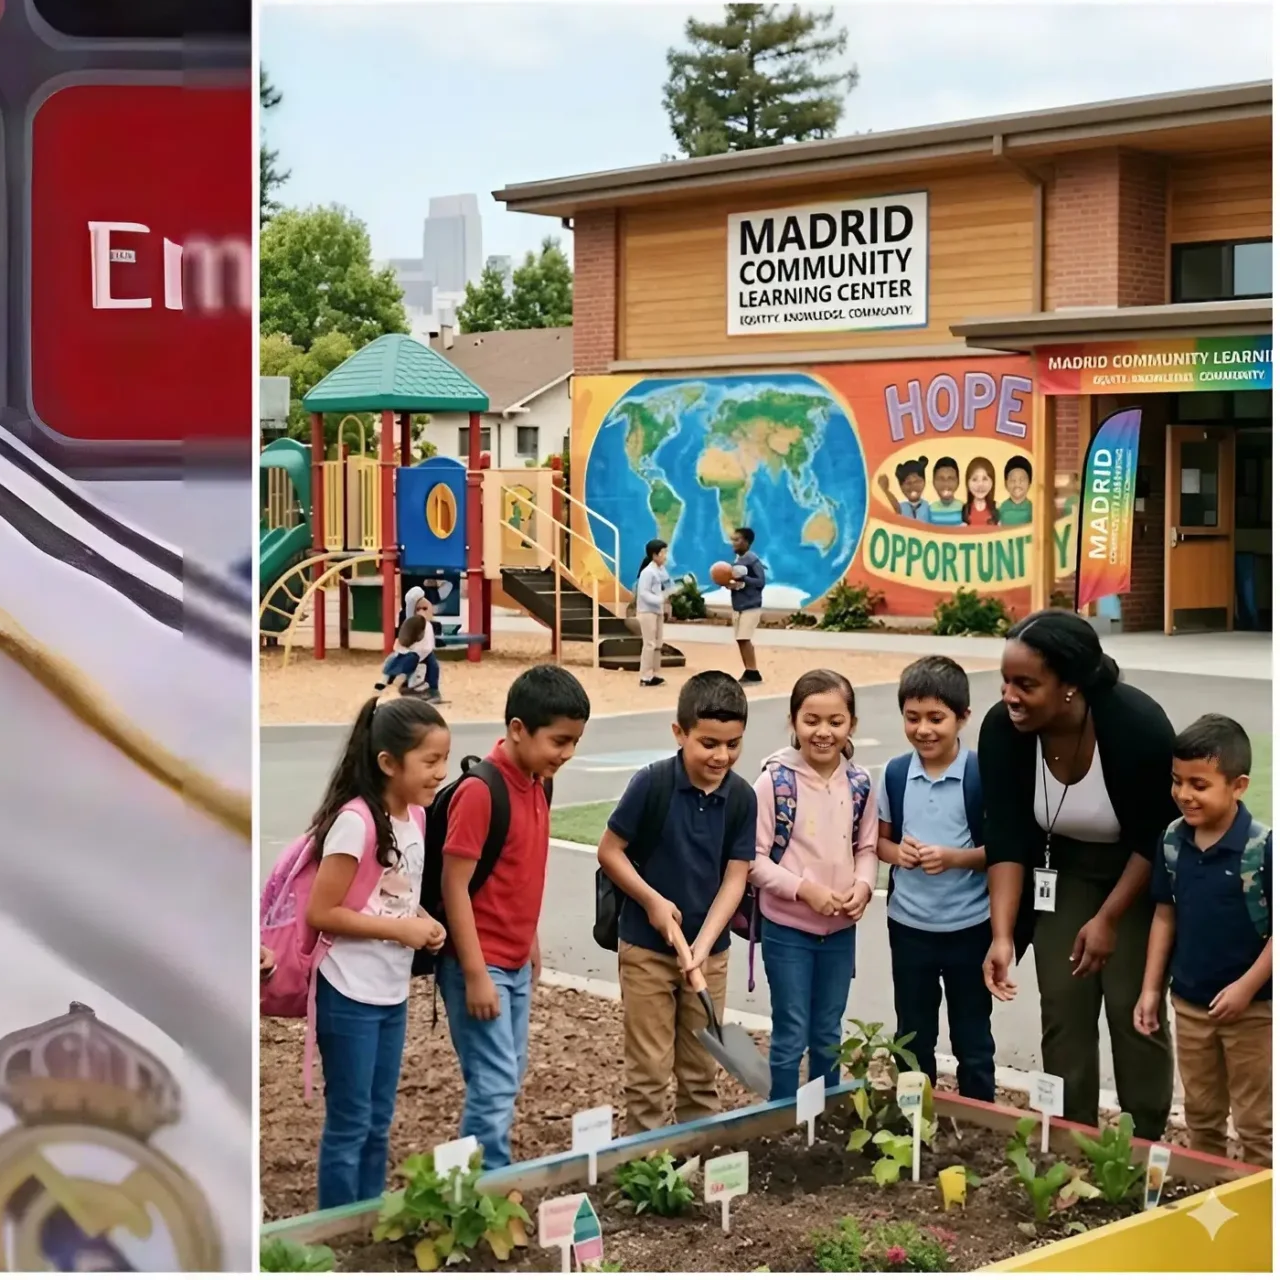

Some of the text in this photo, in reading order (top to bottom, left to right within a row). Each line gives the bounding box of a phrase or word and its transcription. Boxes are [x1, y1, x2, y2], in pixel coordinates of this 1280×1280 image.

[740, 205, 913, 255] MADRID
[740, 247, 912, 285] COMMUNITY
[739, 279, 912, 308] LEARNING CENTER
[1048, 349, 1272, 370] MADRID COMMUNITY LEARNI
[884, 372, 1032, 442] HOPE
[1089, 448, 1112, 559] MADRID
